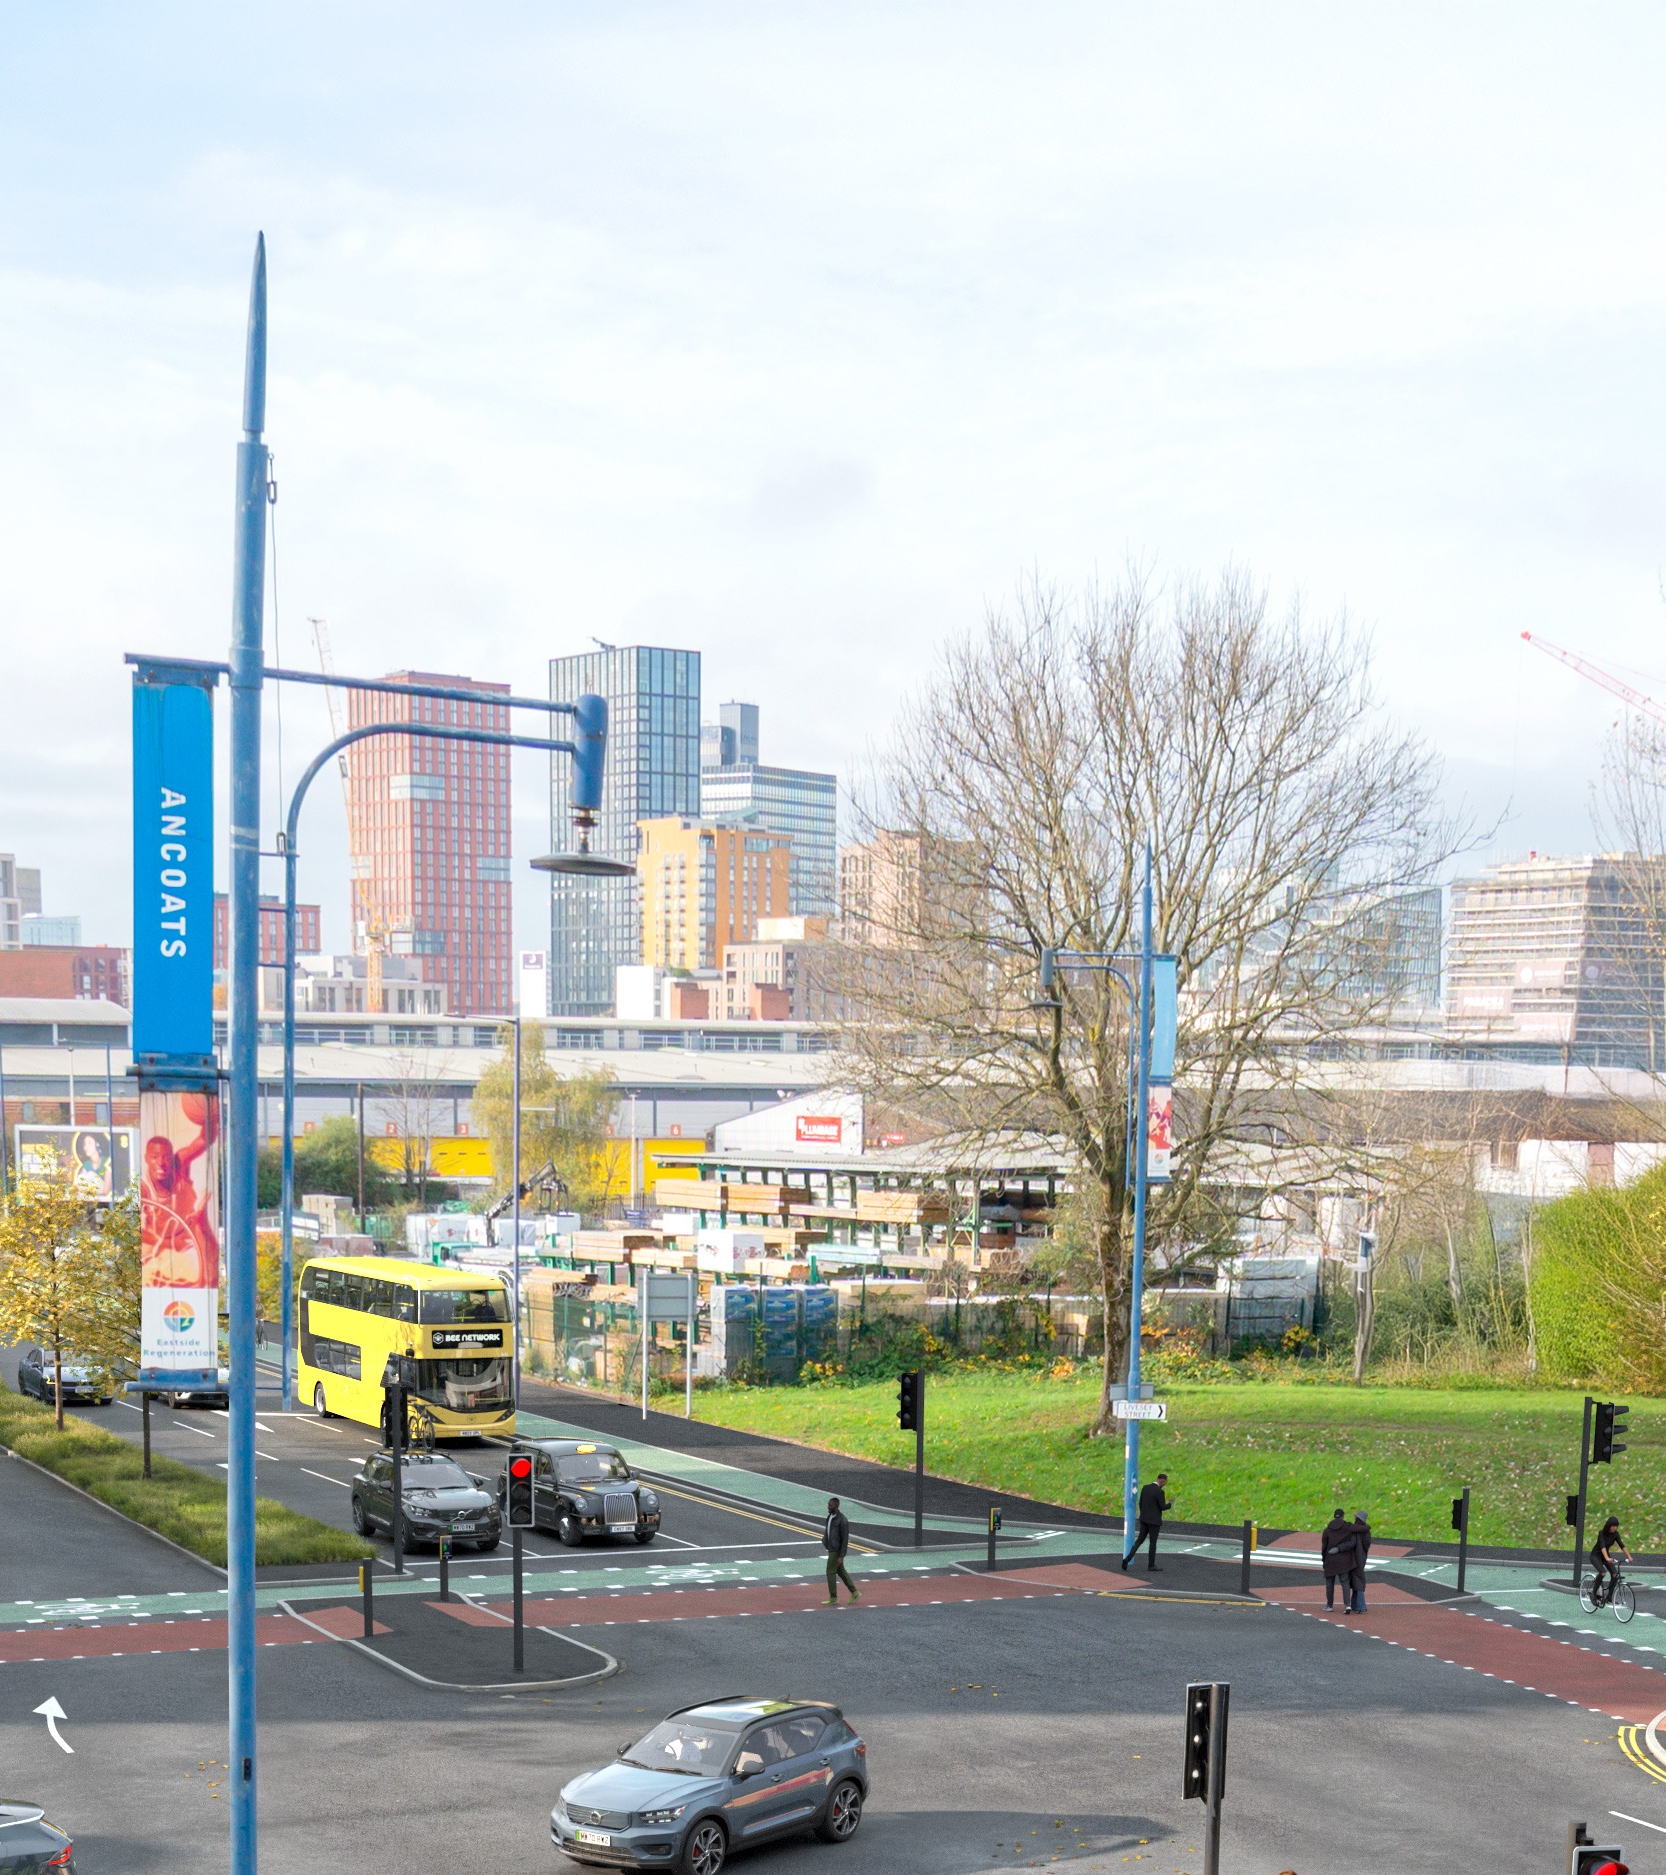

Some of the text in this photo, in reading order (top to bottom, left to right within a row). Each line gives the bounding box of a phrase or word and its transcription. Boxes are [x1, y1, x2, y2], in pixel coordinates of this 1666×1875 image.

[161, 786, 187, 958] ANCOATS
[673, 1126, 678, 1135] 6
[445, 1333, 500, 1342] BEE NETWORK
[143, 1349, 216, 1358] Regeneration
